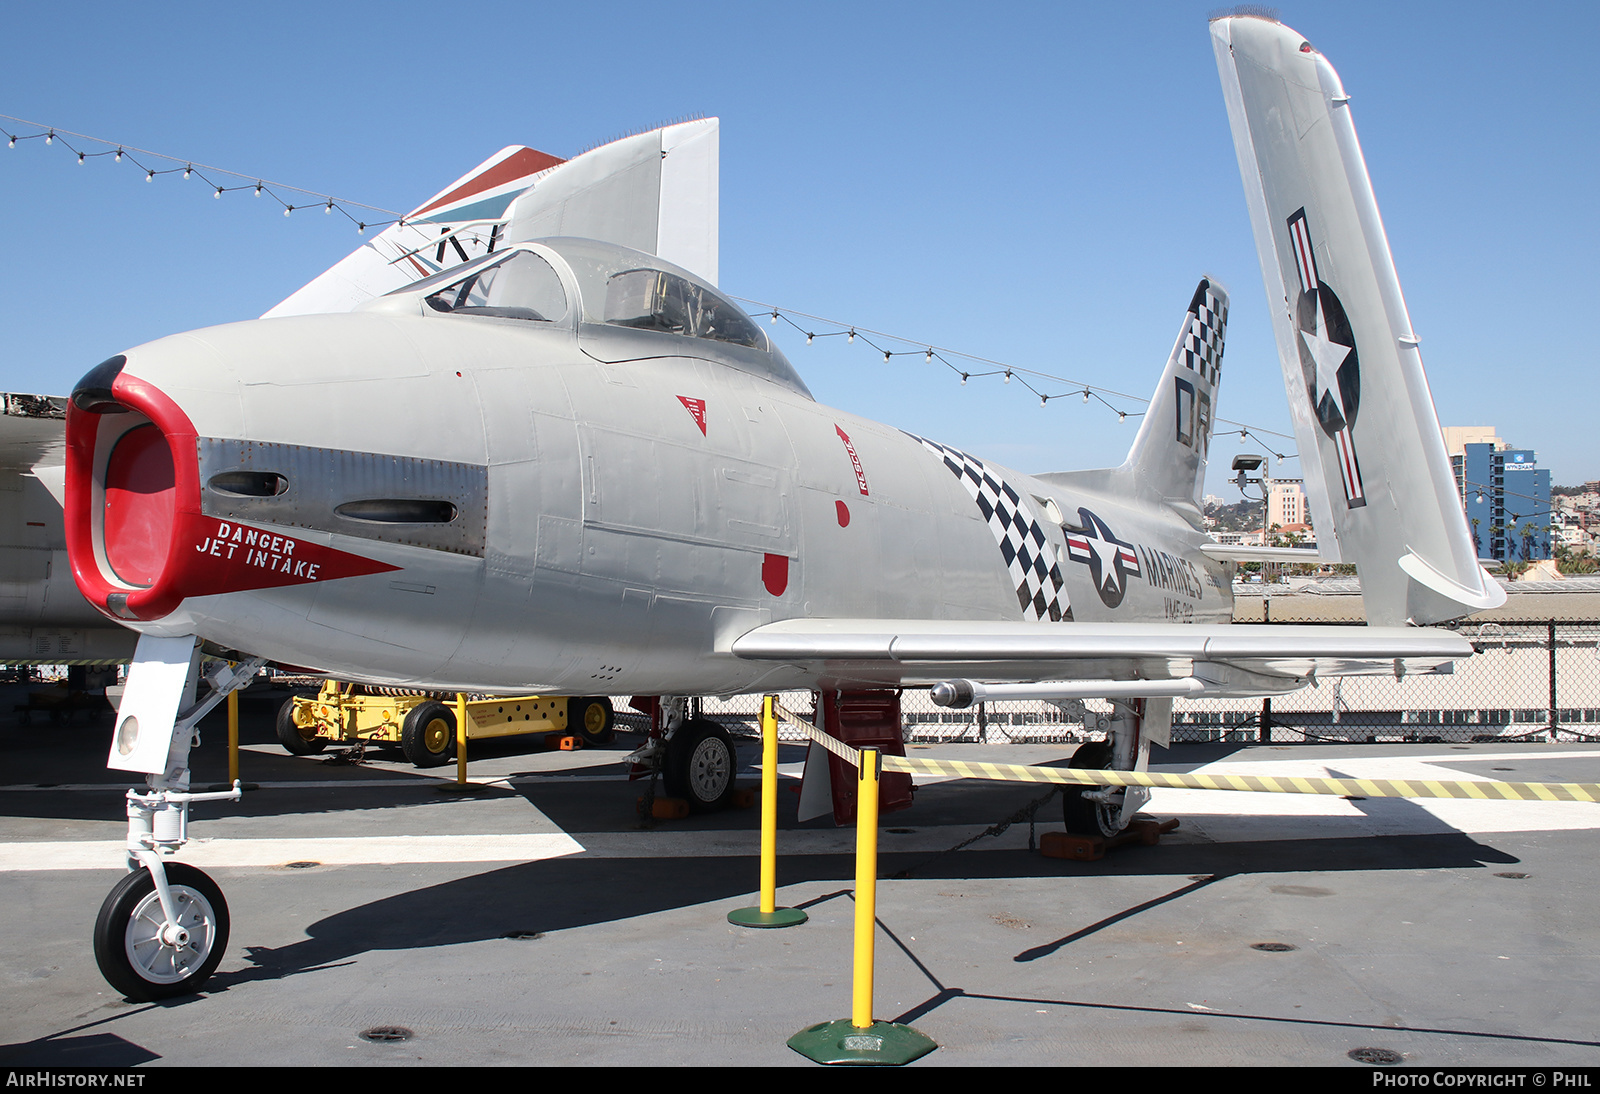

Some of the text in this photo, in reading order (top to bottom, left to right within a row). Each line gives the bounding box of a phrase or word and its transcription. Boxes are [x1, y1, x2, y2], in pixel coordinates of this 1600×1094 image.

[1174, 376, 1211, 460] DR
[843, 440, 868, 491] RESCUE
[196, 537, 321, 580] JET INTAKE
[217, 522, 295, 556] DANGER
[1138, 543, 1203, 600] MARINES
